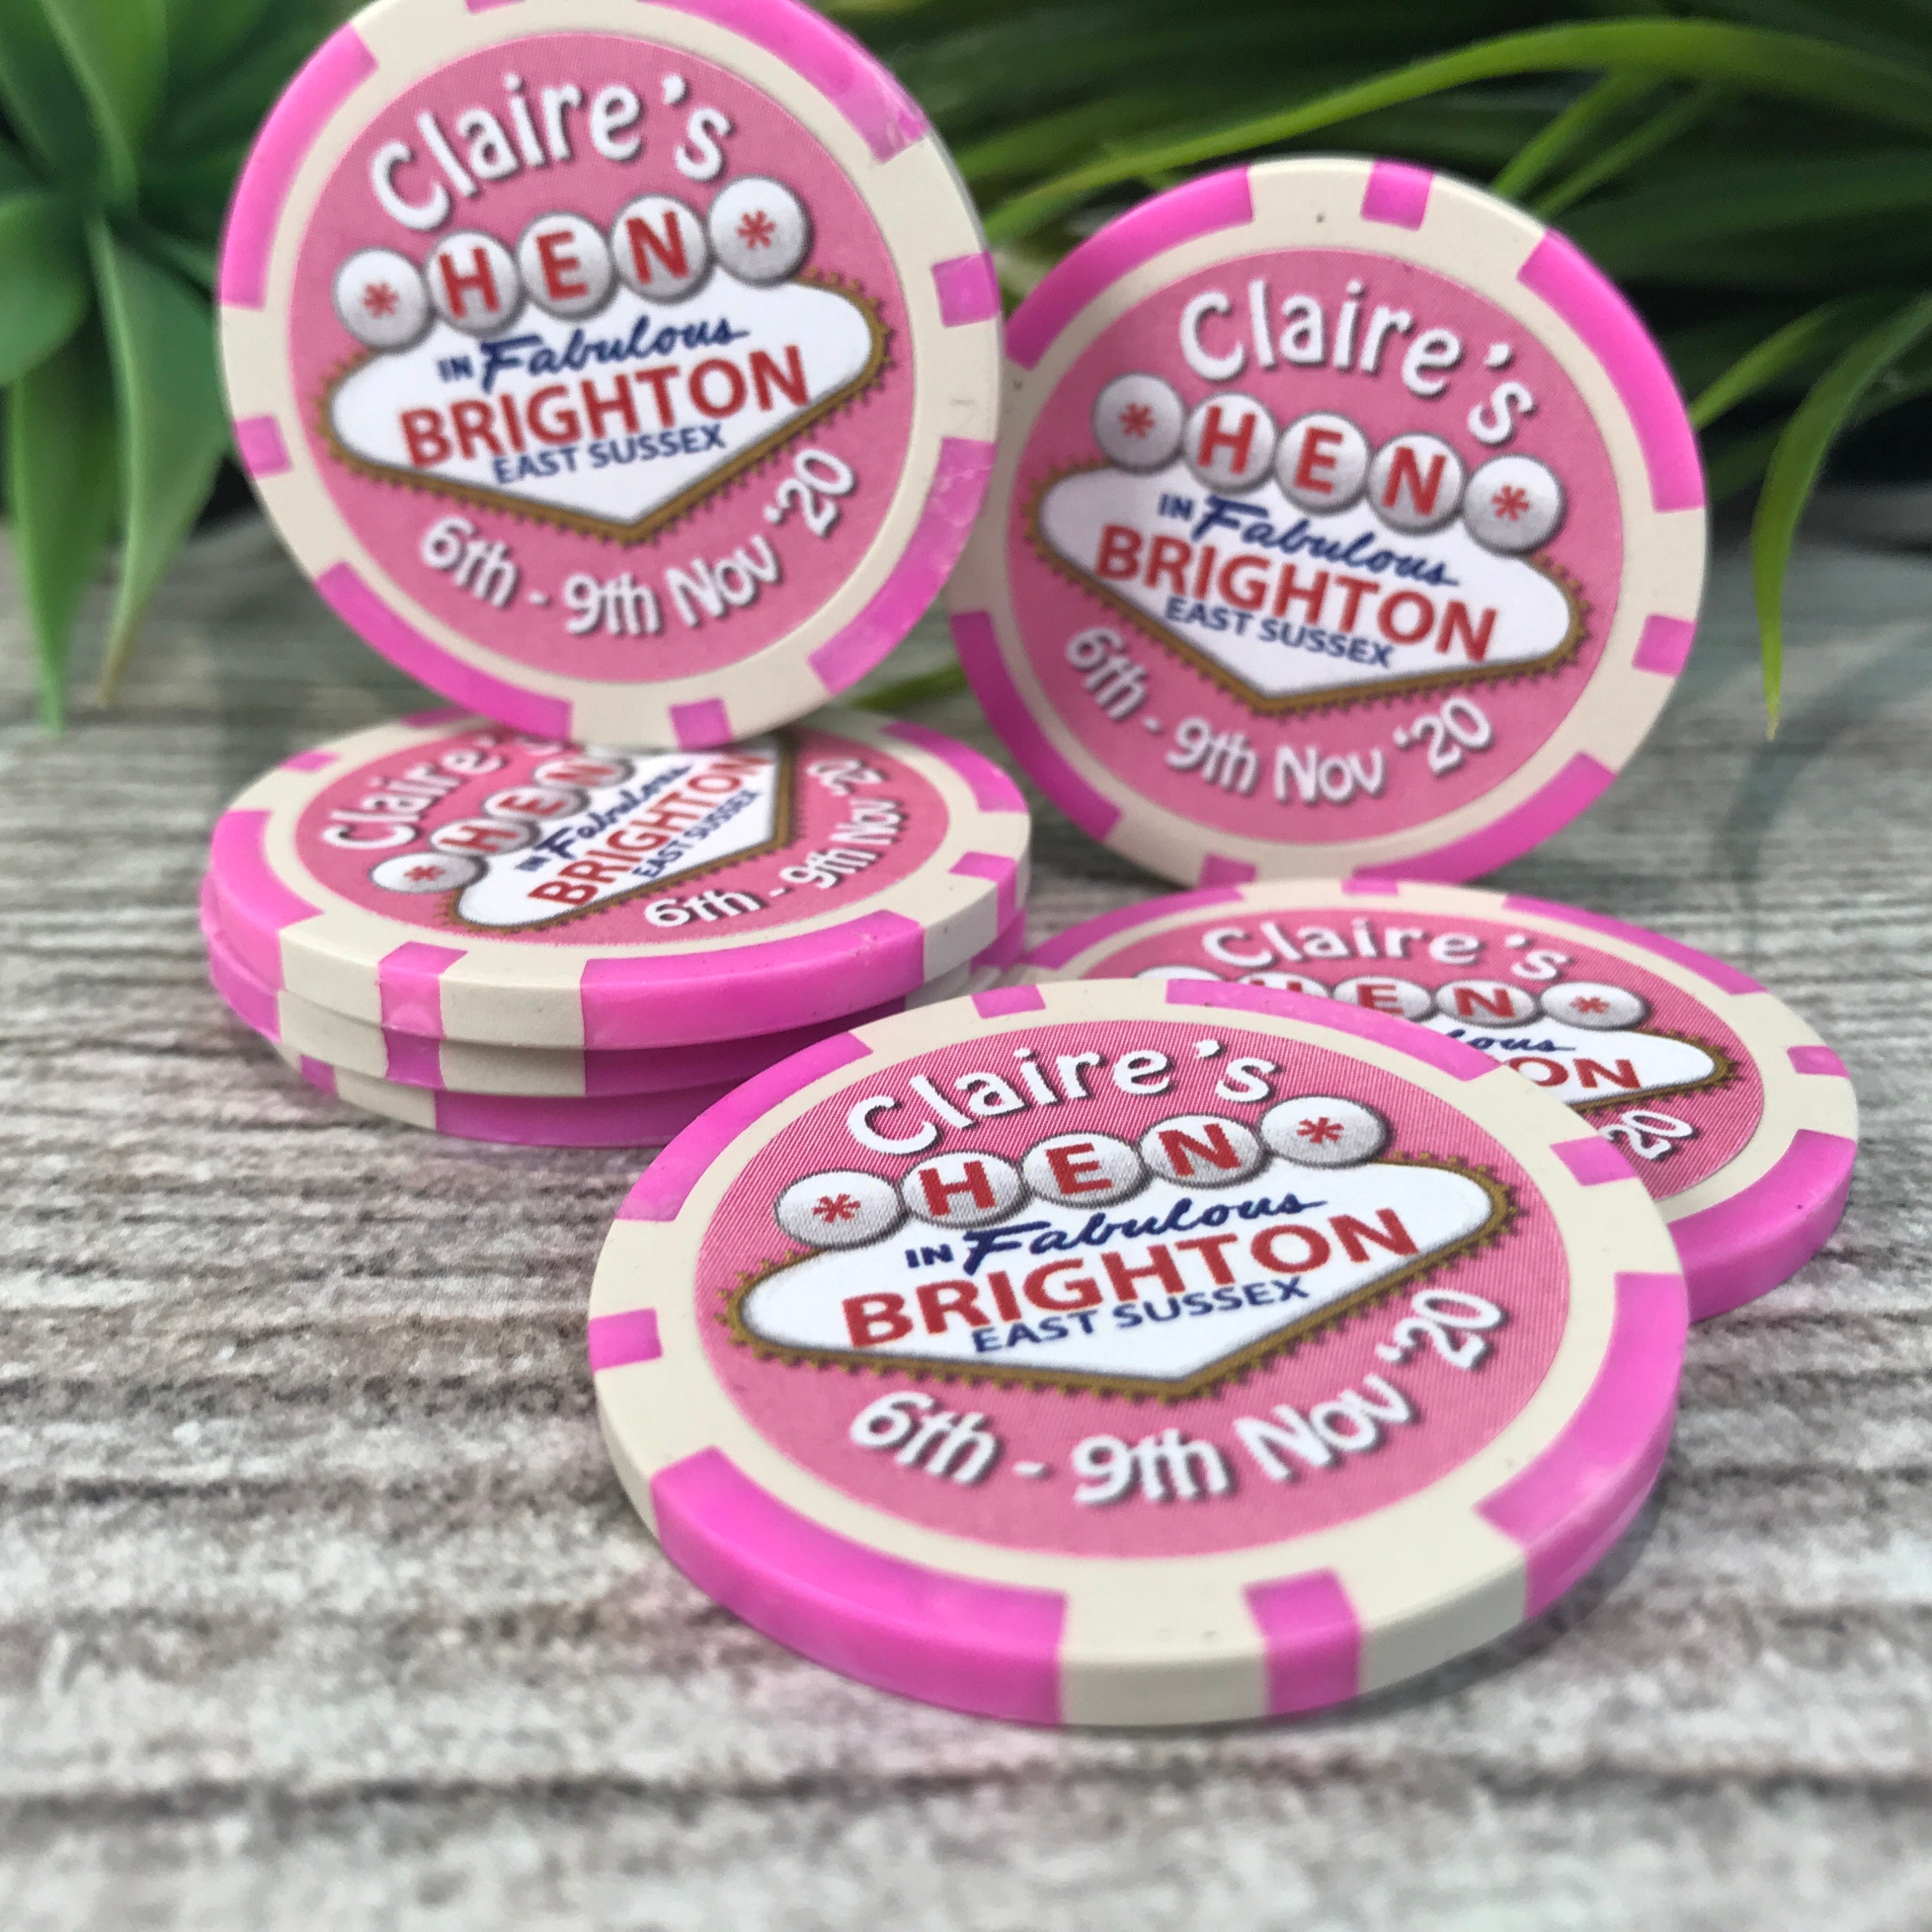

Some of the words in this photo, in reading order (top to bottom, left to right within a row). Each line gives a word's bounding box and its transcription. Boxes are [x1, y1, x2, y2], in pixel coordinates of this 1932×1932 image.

[370, 72, 733, 232] Claire's
[437, 210, 689, 318] HEN
[437, 354, 475, 383] IN
[480, 316, 750, 395] Fabulous
[1179, 279, 1535, 446] Claire's
[399, 345, 810, 468] BRIGHTON
[493, 445, 580, 484] EAST
[589, 422, 727, 467] SUSSEX
[1197, 405, 1447, 515] HEN
[421, 516, 517, 608] 6th
[564, 576, 660, 636] 9th
[666, 533, 779, 627] Nov
[1158, 493, 1193, 522] IN
[1192, 495, 1459, 587] Fabulous
[1095, 524, 1497, 662] BRIGHTON
[1164, 596, 1252, 637] EAST
[1261, 620, 1396, 668] SUSSEX
[1065, 627, 1146, 721] 6th
[1165, 717, 1258, 795] 9th
[1273, 746, 1387, 804] Nov
[440, 762, 616, 852] HEN
[527, 753, 772, 906] BRIGHTON
[829, 797, 903, 846] Nov
[632, 839, 694, 878] EAST
[779, 848, 881, 889] 9th
[645, 889, 763, 927] 6th
[1201, 917, 1571, 981] Claire's
[1249, 979, 1518, 1019] EN
[846, 1039, 1280, 1157] Claire's
[917, 1122, 1240, 1216] HEN
[841, 1207, 1419, 1349] BRIGHTON
[905, 1243, 954, 1269] IN
[963, 1192, 1327, 1275] Fabulous
[971, 1311, 1097, 1354] EAST
[1113, 1275, 1311, 1328] SUSSEX
[849, 1390, 998, 1484] 6th
[1072, 1431, 1233, 1506] 9th
[1235, 1372, 1414, 1482] Nov
